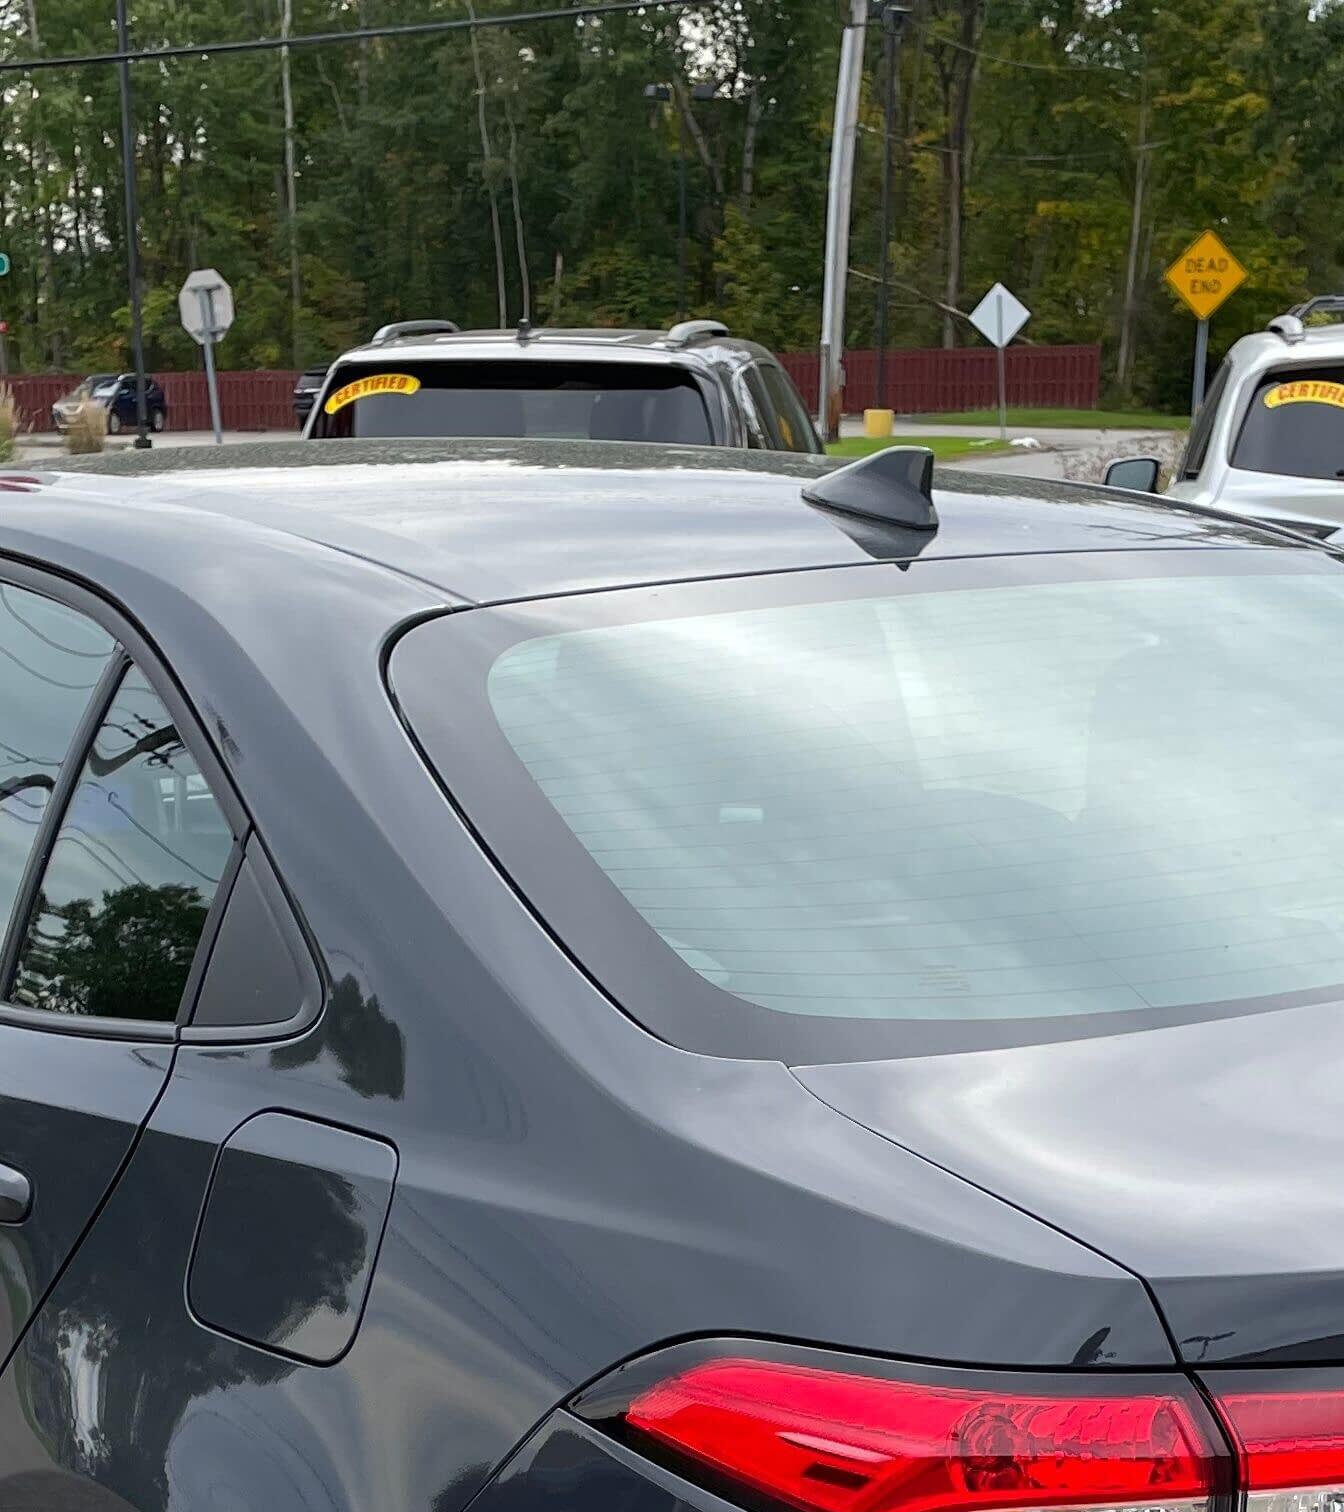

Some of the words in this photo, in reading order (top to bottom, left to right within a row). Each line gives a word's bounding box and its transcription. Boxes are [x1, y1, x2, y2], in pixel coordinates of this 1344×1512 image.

[1185, 257, 1229, 274] DEAD
[1190, 279, 1222, 295] END
[336, 376, 408, 405] CERTIFIED
